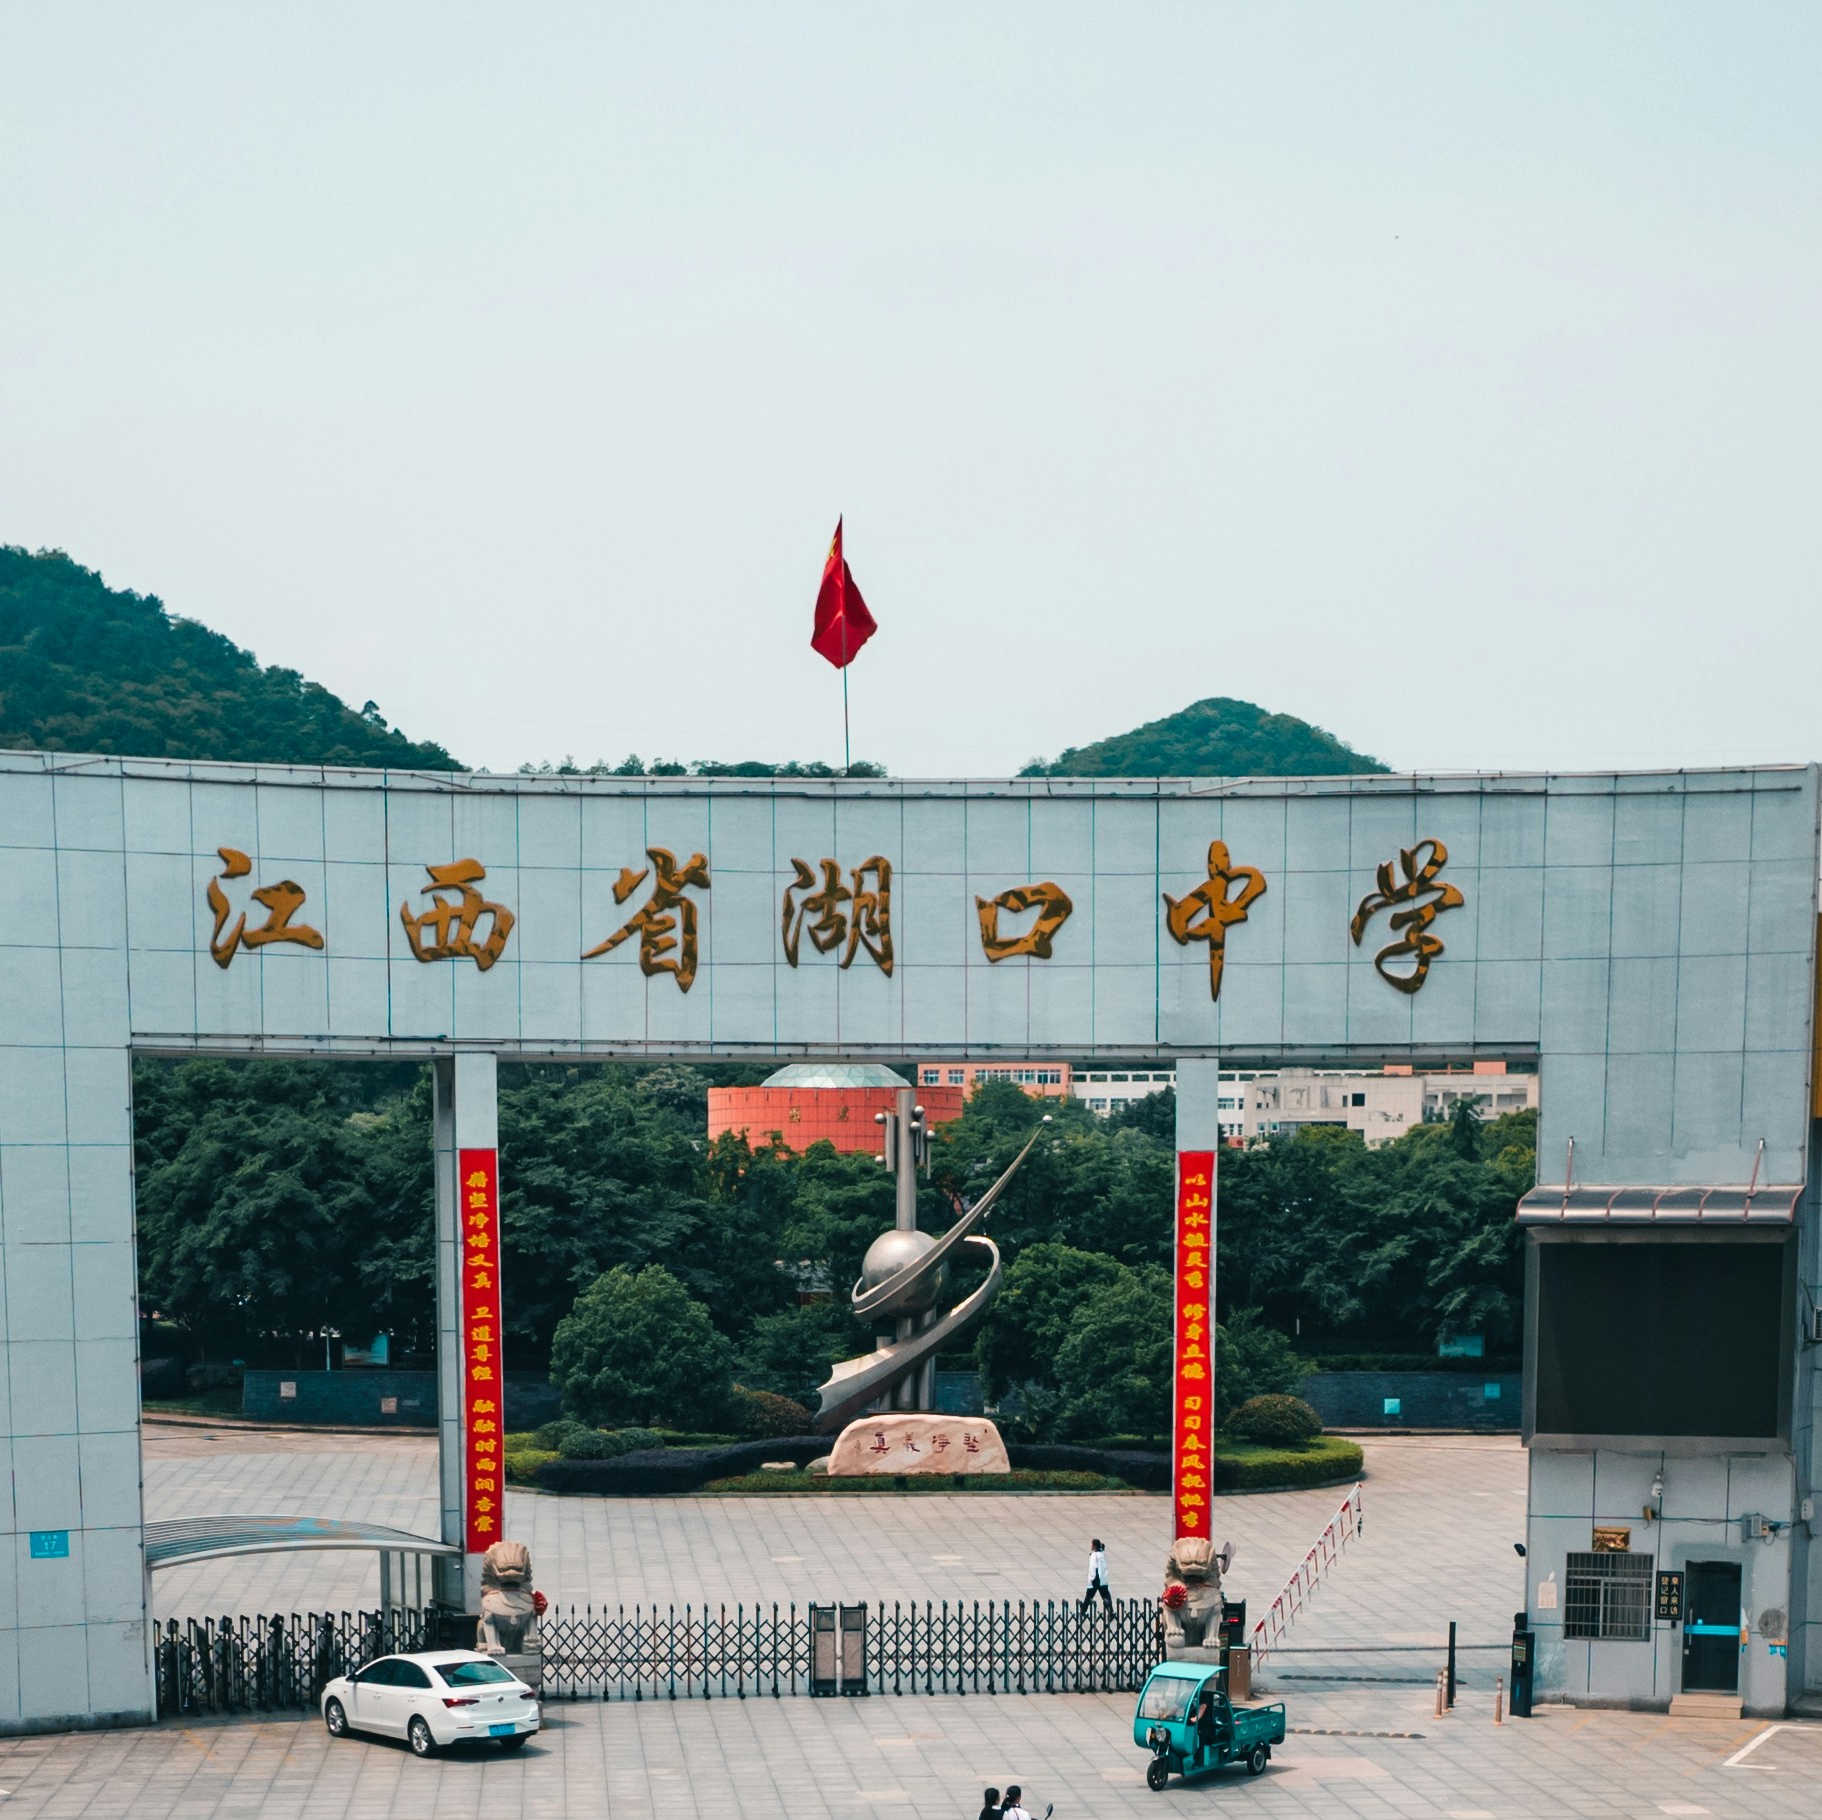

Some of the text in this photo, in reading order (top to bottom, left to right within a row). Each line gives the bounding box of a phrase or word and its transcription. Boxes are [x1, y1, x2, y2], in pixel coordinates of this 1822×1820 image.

[209, 839, 1463, 1001] 江西省湖口中学
